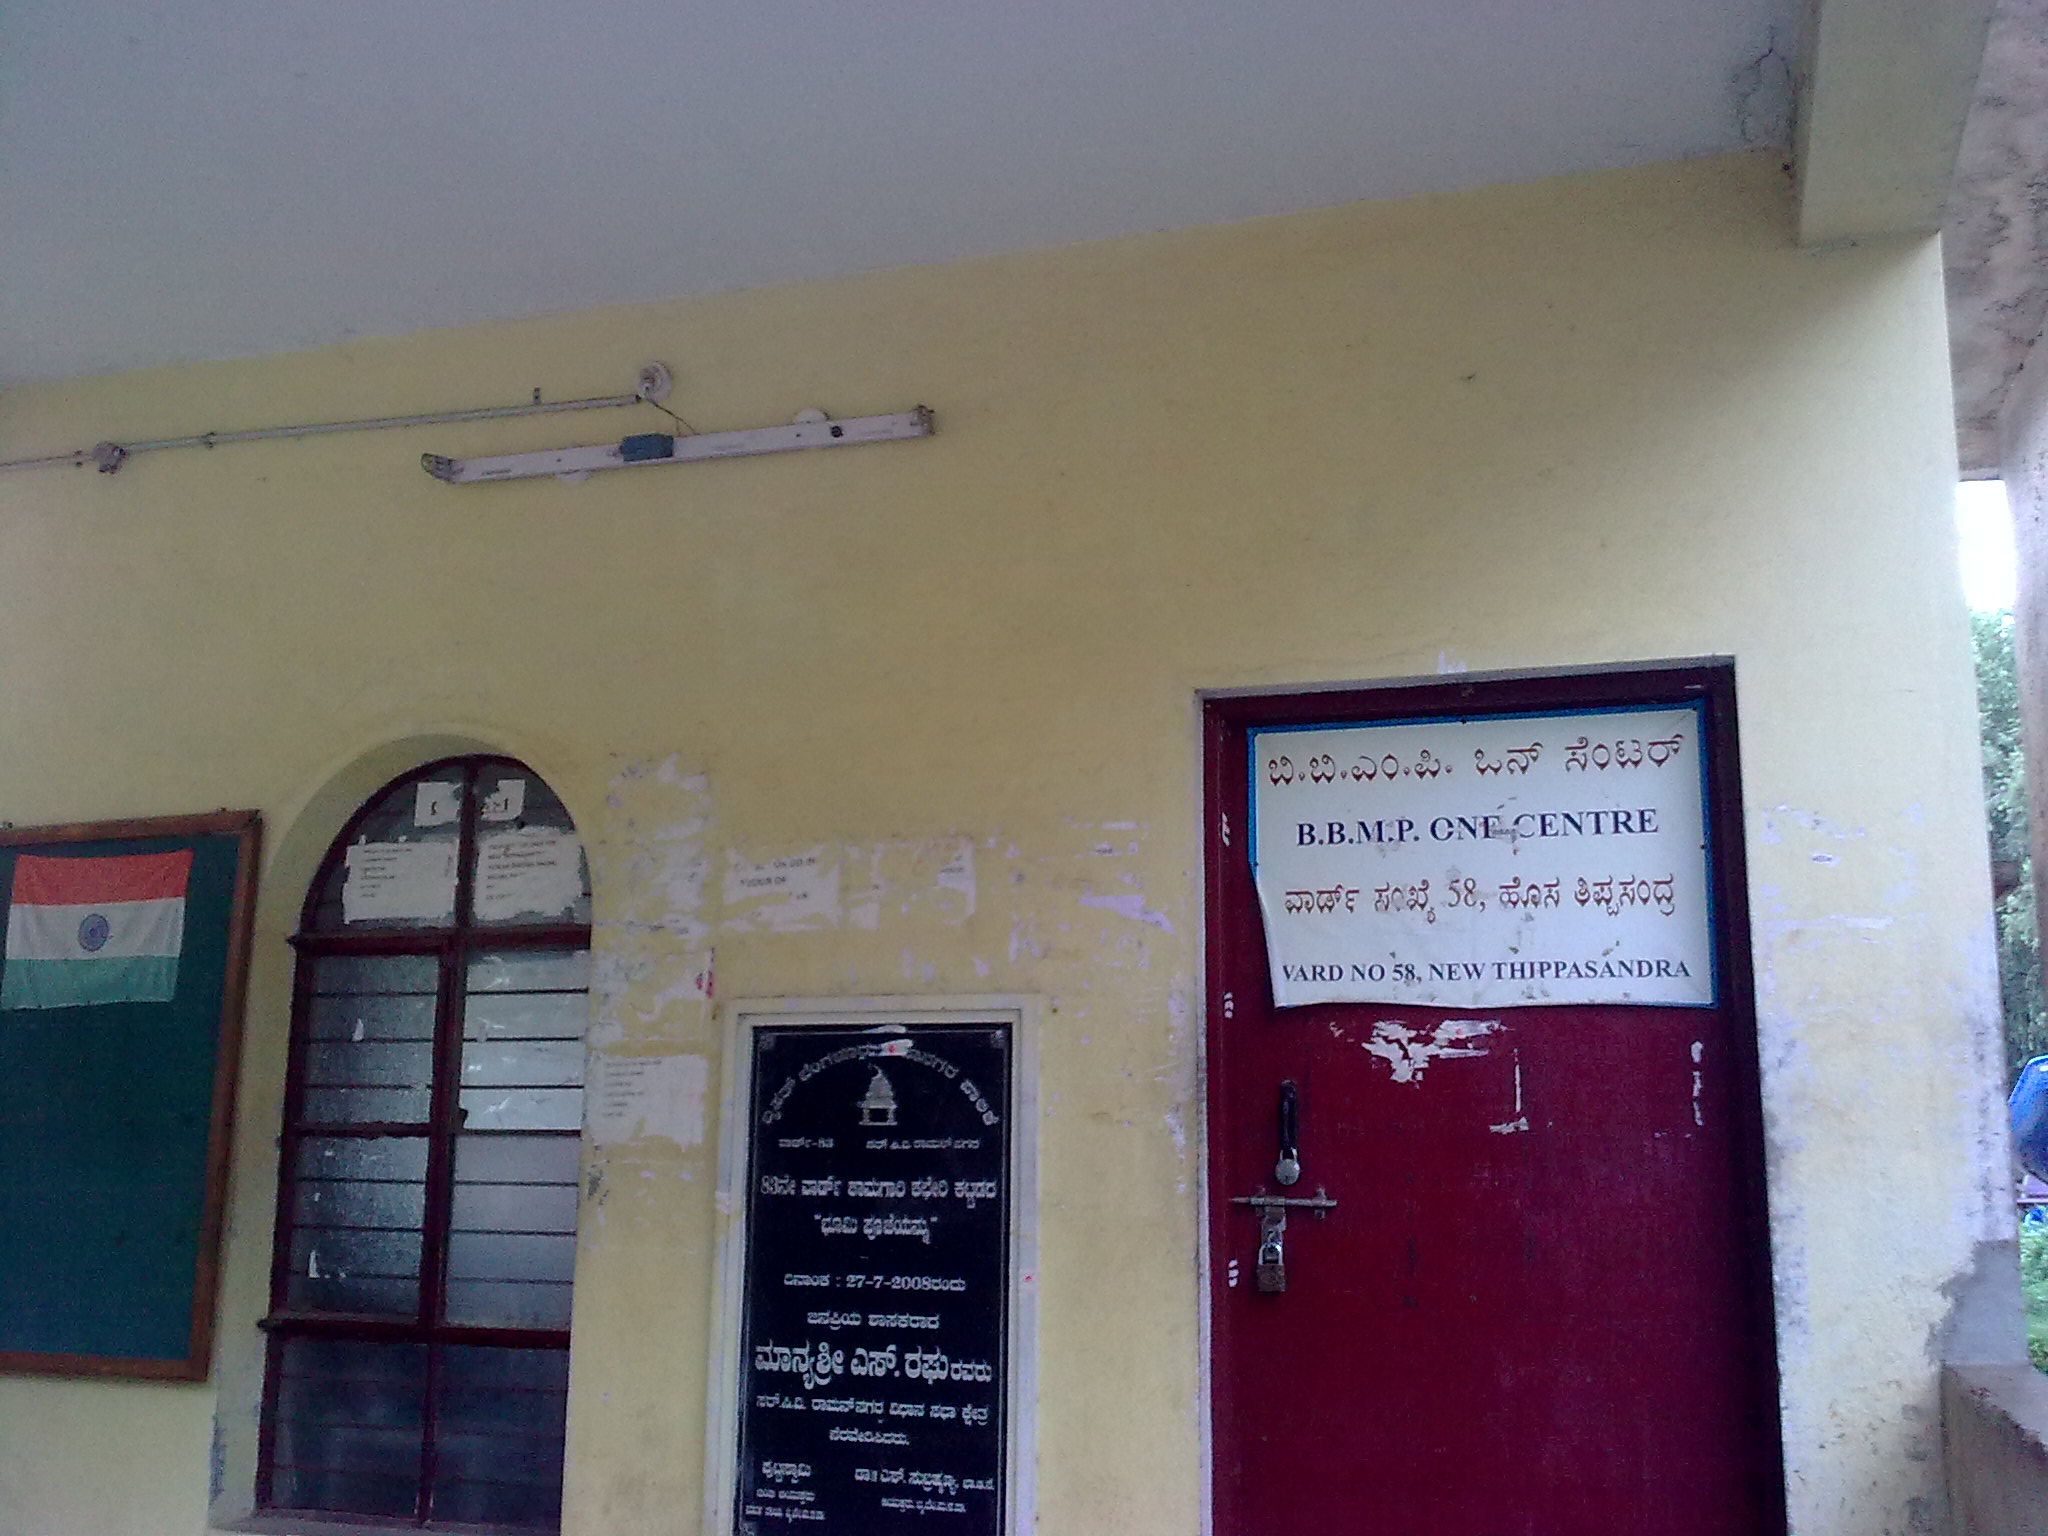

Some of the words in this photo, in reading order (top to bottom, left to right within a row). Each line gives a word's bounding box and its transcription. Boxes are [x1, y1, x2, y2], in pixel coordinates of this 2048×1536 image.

[1268, 748, 1453, 786] ಬಿ.ಬಿ.ಎಂ.ಪಿ.
[1475, 742, 1543, 775] ಒನ್
[1565, 733, 1684, 773] ಸೆಂಟರ್
[1297, 820, 1419, 846] B.B.M.P.
[1430, 815, 1500, 841] ONE
[1513, 808, 1659, 838] CENTRE
[1447, 877, 1487, 913] 58,
[1499, 876, 1560, 909] ಹೊಸ
[1574, 873, 1676, 917] ತಿಪ್ಪಸಂದ್ರ
[1350, 962, 1386, 983] NO
[1391, 962, 1423, 983] 58,
[1428, 961, 1486, 982] NEW
[1492, 959, 1691, 981] THIPPASANDRA
